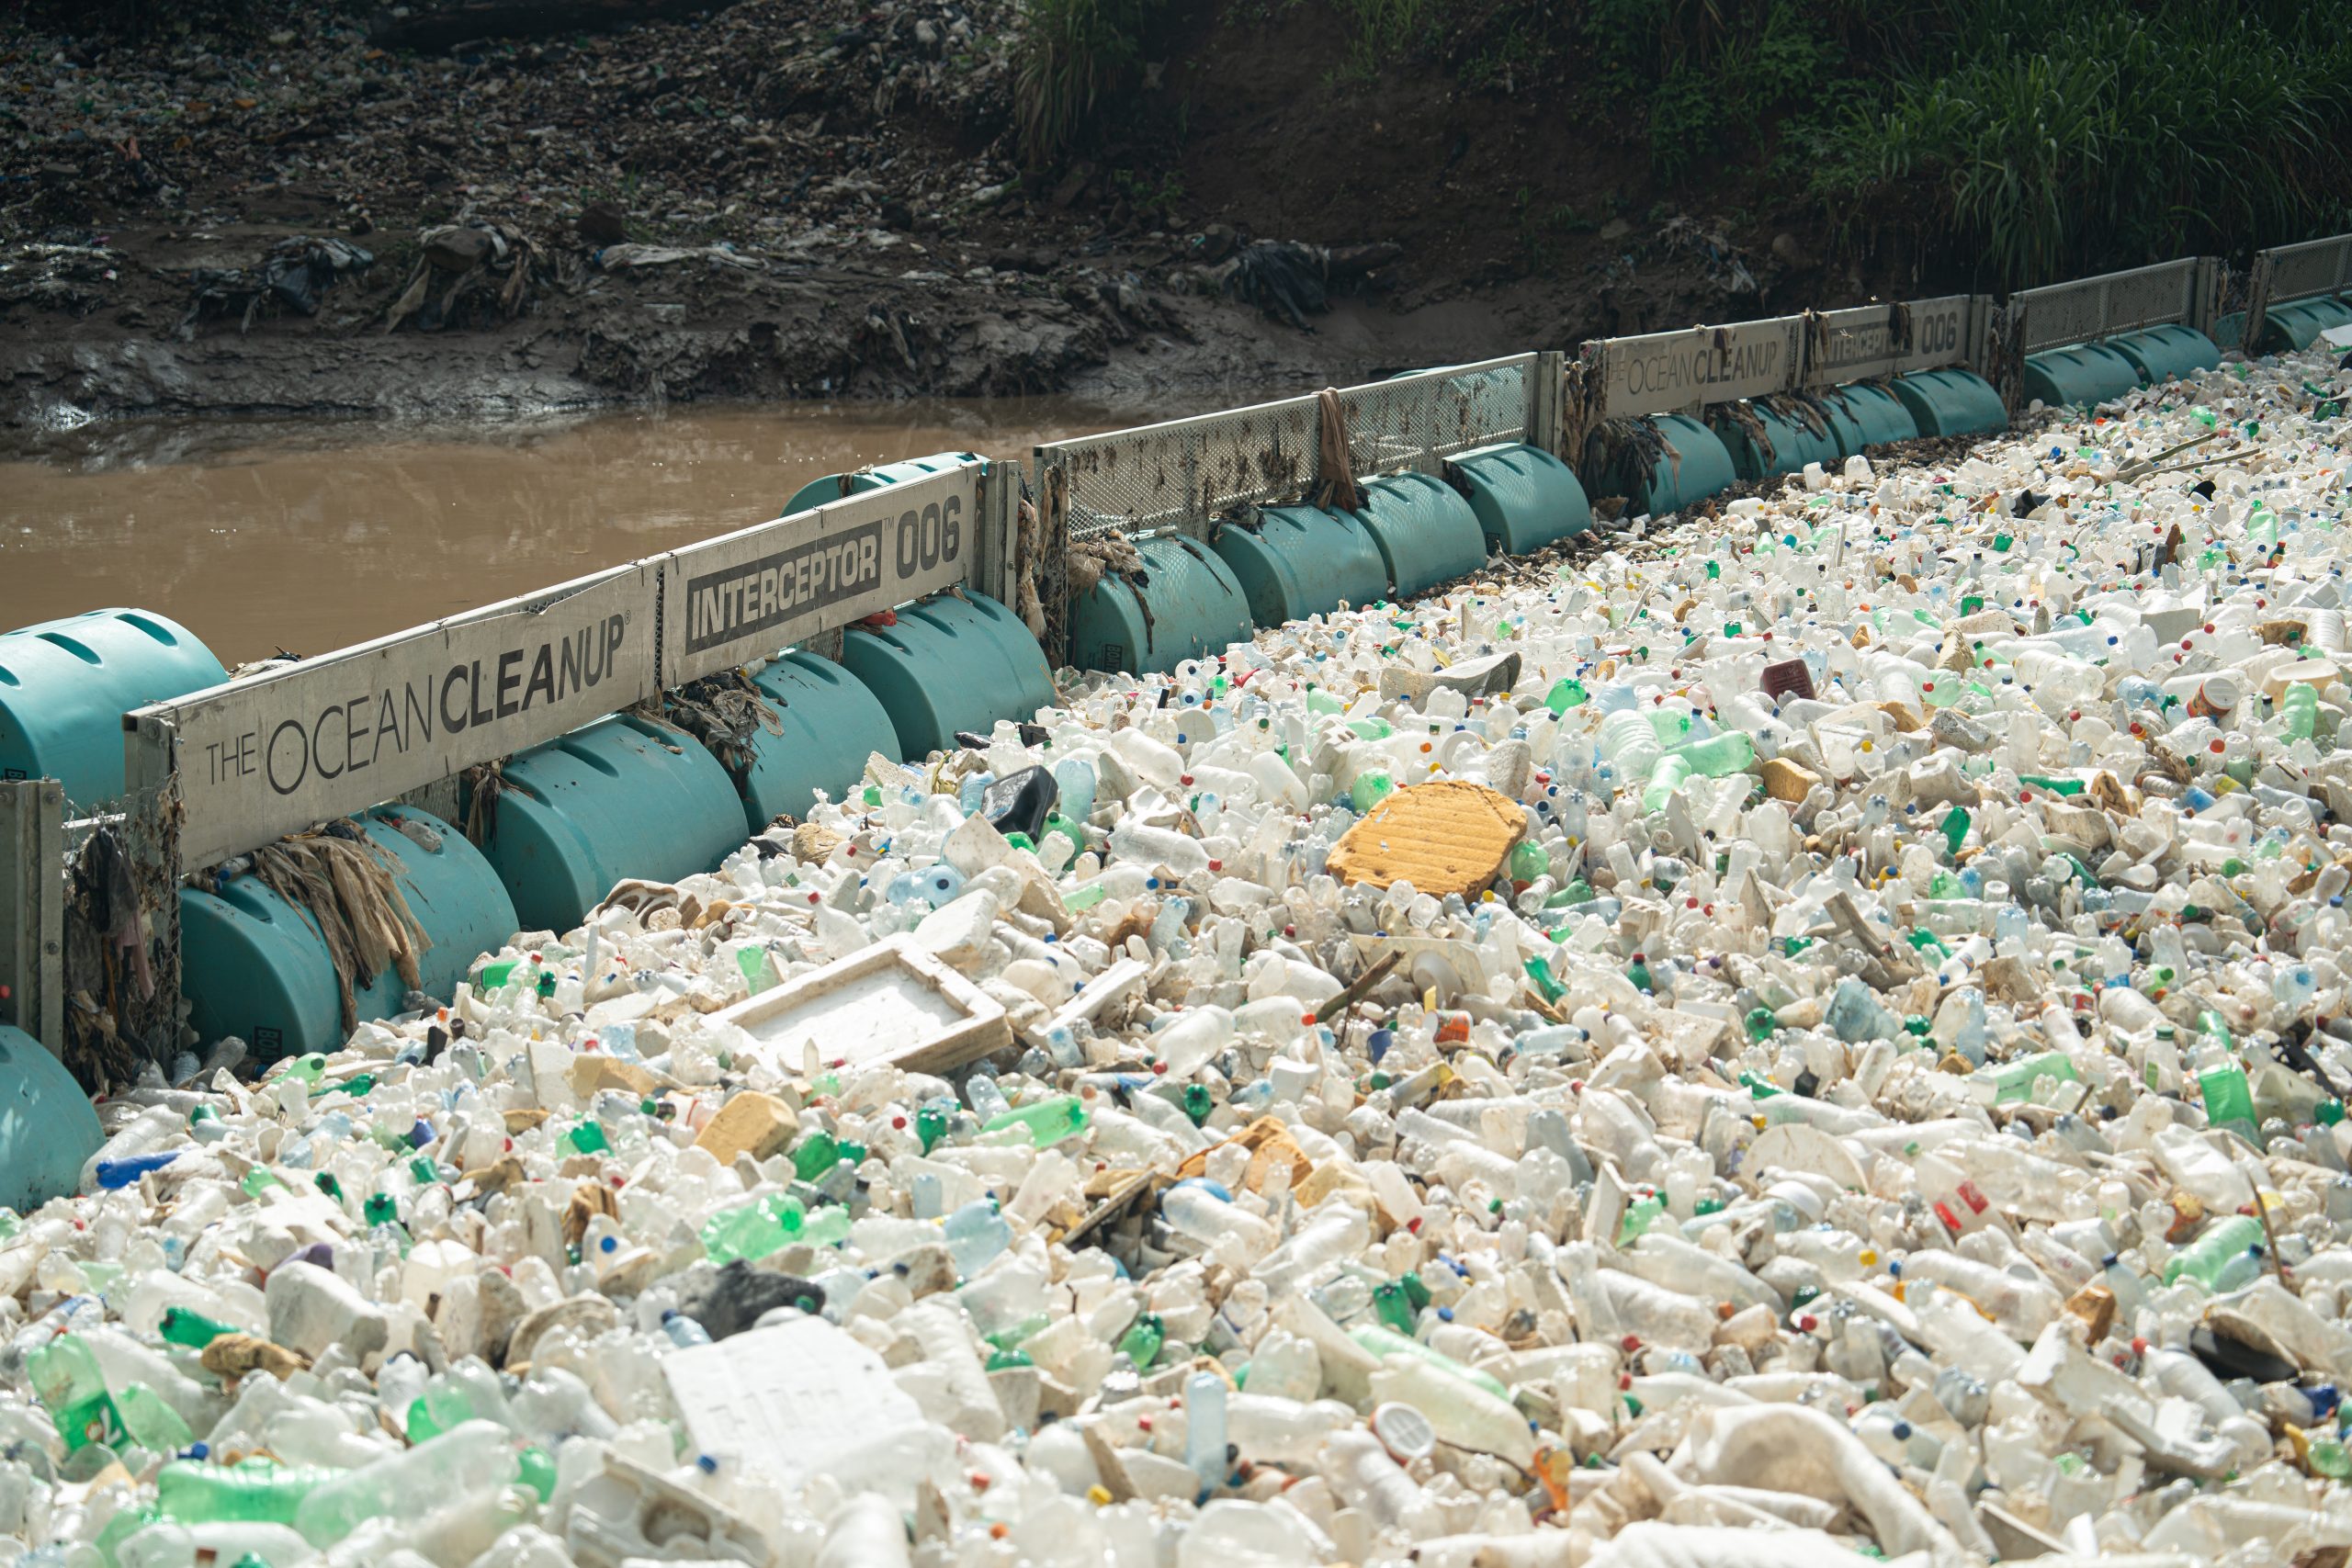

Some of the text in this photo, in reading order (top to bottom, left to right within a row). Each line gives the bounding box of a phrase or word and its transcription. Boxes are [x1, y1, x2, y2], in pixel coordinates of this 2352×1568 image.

[1921, 311, 1958, 355] 006
[691, 534, 877, 641] INTERCEPTOR
[896, 494, 962, 580] 006
[205, 731, 256, 785] THE
[266, 673, 434, 795] OCEAN
